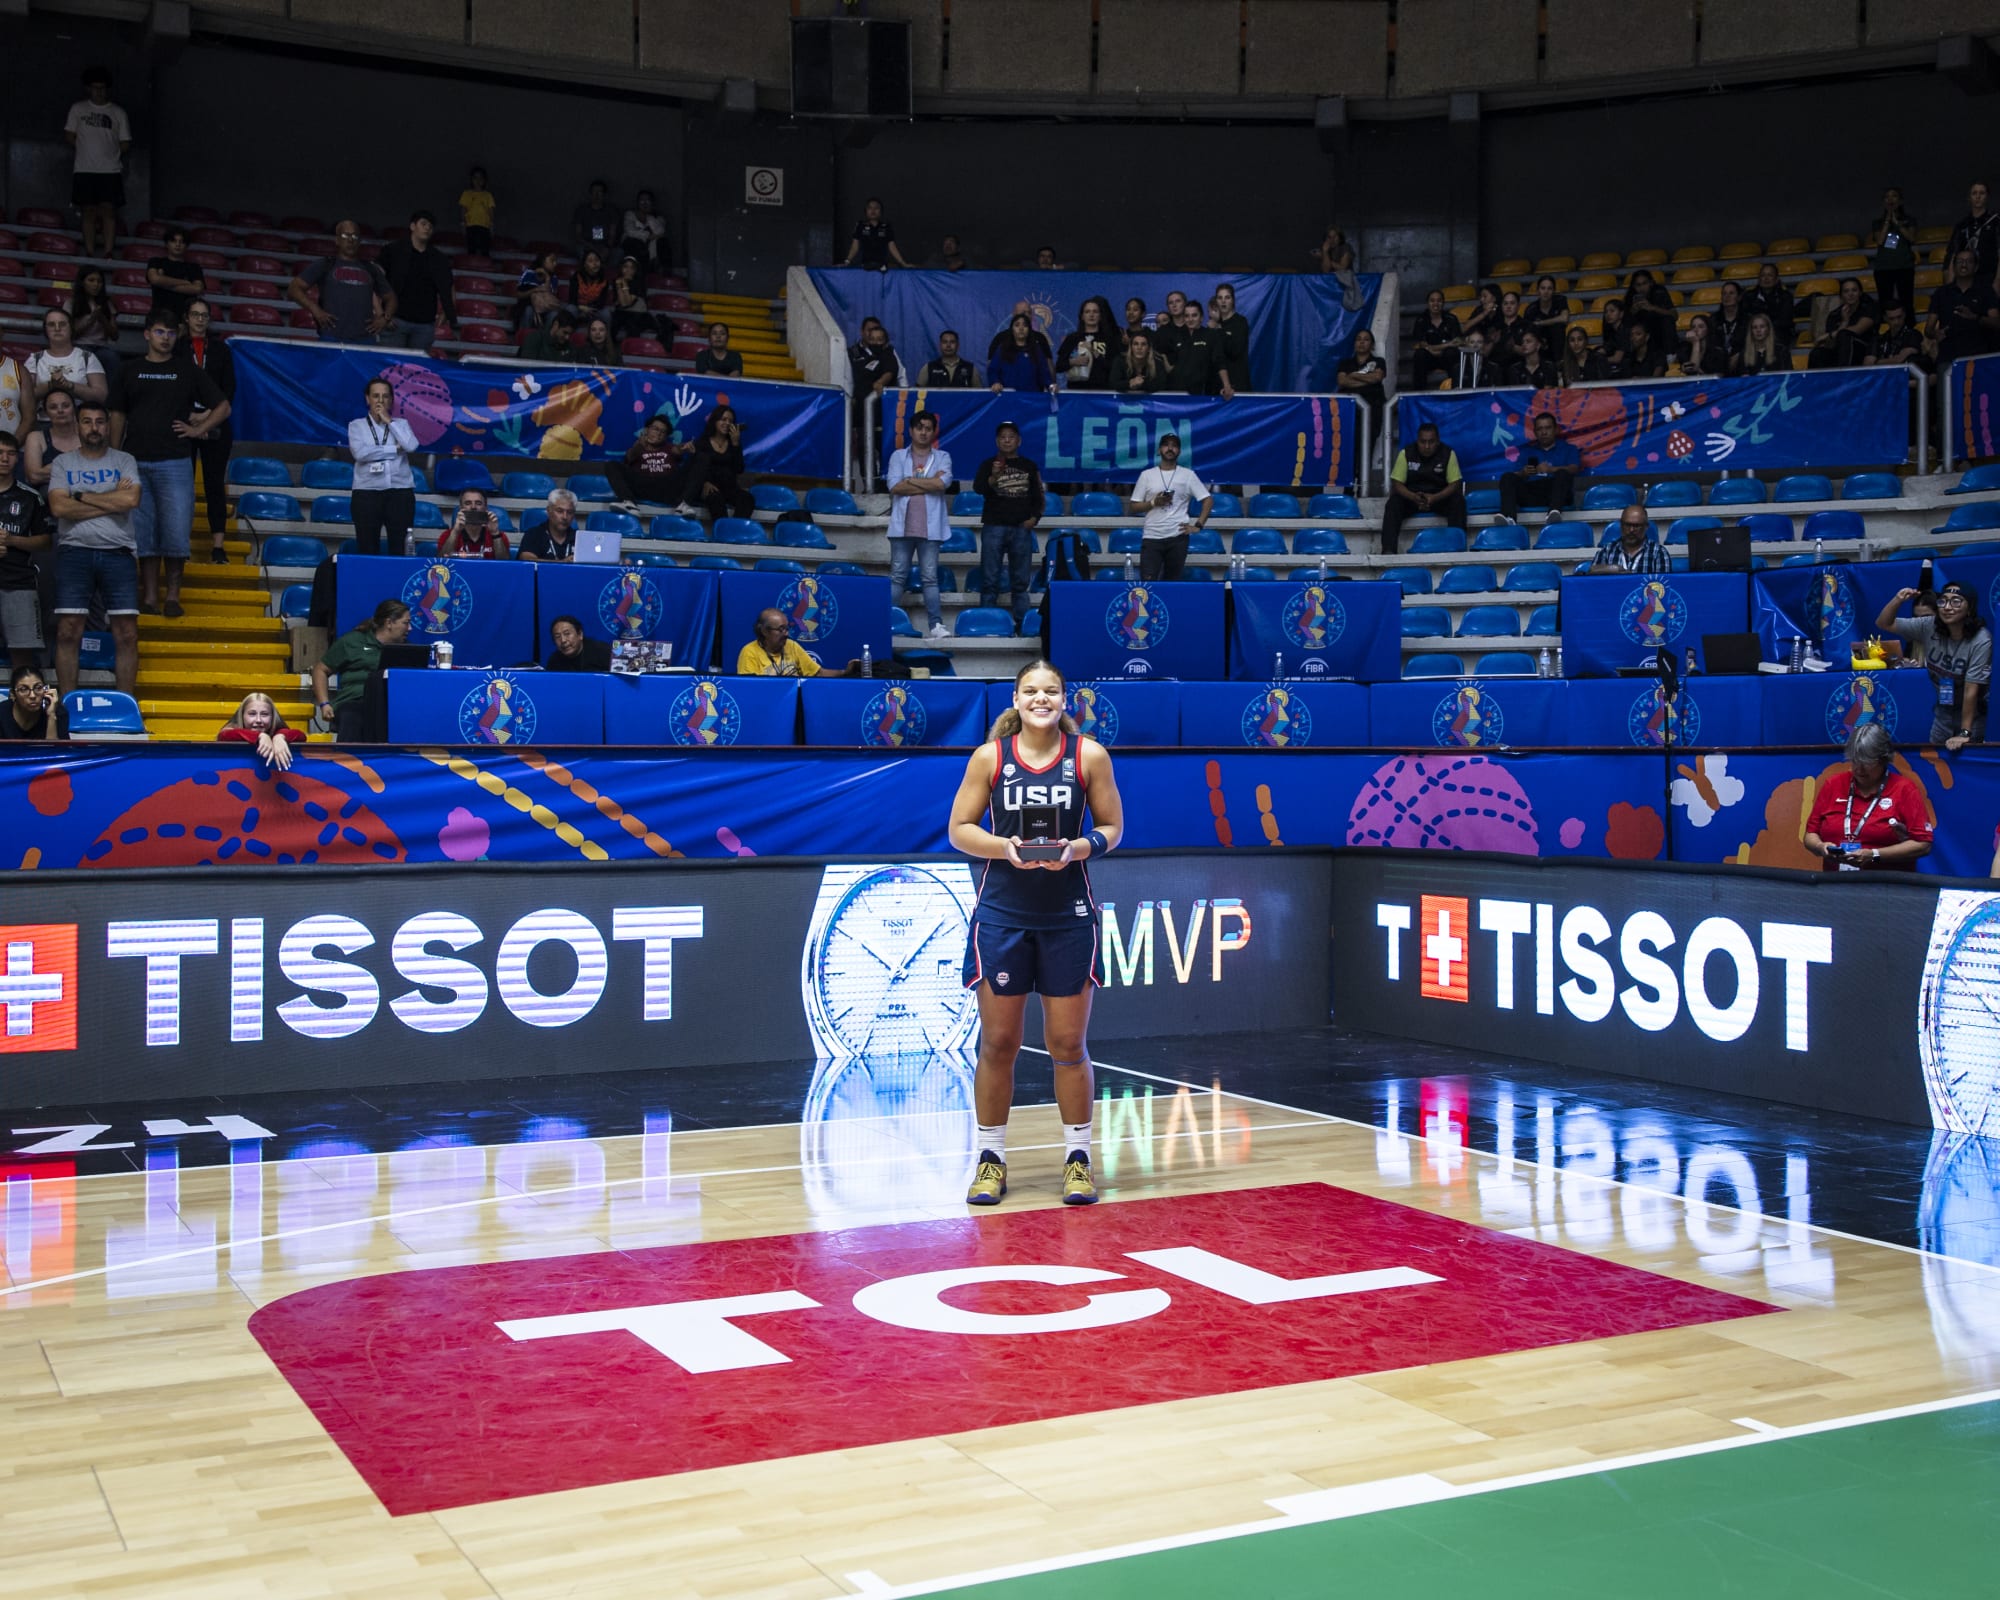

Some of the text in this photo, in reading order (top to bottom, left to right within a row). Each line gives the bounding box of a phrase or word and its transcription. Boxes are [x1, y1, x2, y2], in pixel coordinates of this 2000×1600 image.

[1128, 664, 1147, 674] FIBA
[1305, 664, 1324, 673] FIBA
[1928, 646, 1967, 674] USA
[1003, 785, 1071, 811] USA
[881, 918, 913, 927] TISSOT
[1098, 898, 1251, 988] MVP
[107, 906, 704, 1046] TISSOT
[1479, 898, 1832, 1052] TISSOT
[494, 1245, 1447, 1374] TCL
